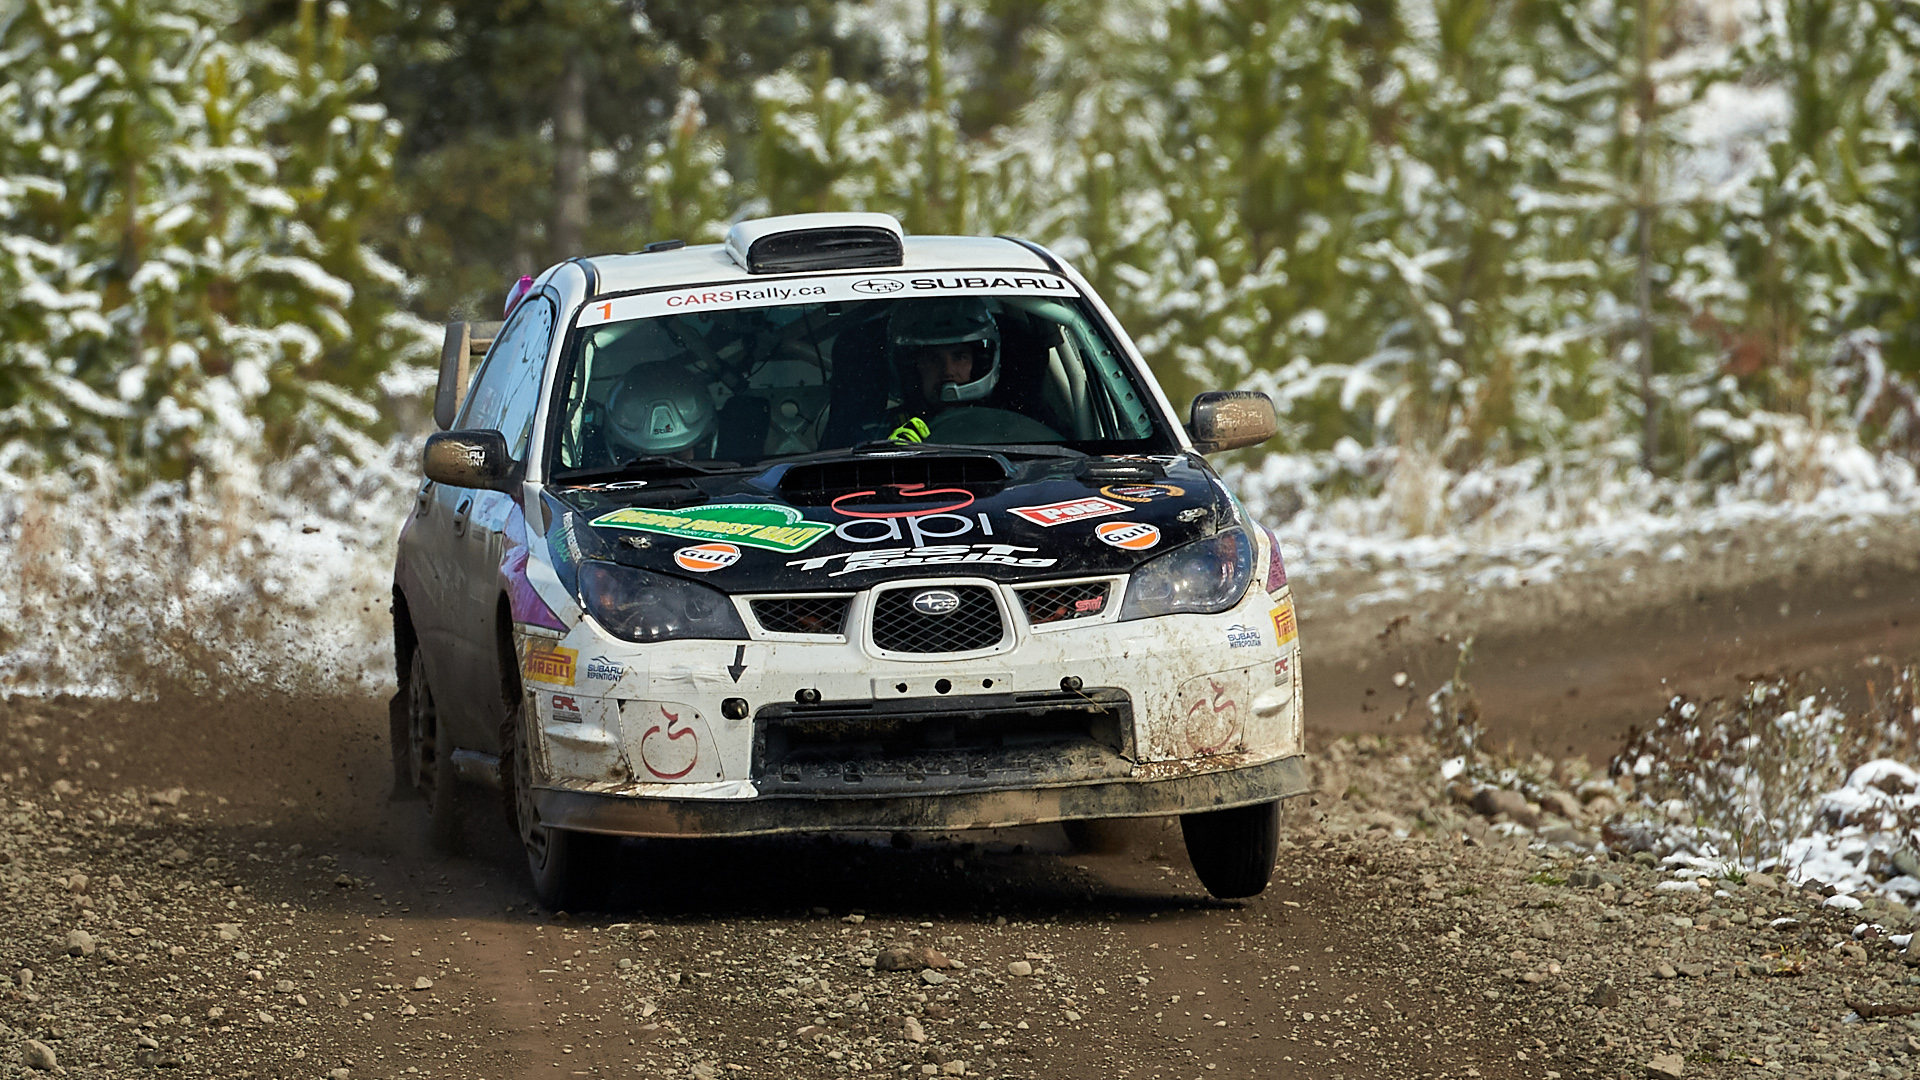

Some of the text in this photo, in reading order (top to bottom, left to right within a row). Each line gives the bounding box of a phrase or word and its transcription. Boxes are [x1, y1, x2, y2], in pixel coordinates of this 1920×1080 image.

[910, 278, 1066, 289] SUBARU
[666, 286, 827, 307] CARSRally.ca
[597, 302, 612, 320] 1
[1037, 503, 1111, 520] Pole
[681, 519, 766, 536] FOREST
[749, 525, 826, 546] RALLY
[1105, 524, 1154, 542] Gulf
[681, 549, 737, 564] Gulf
[786, 544, 1039, 571] TEST
[828, 553, 1058, 577] Racing
[1227, 632, 1261, 642] SUBARU
[528, 650, 572, 679] PIRELLI
[587, 664, 625, 675] SUBARU
